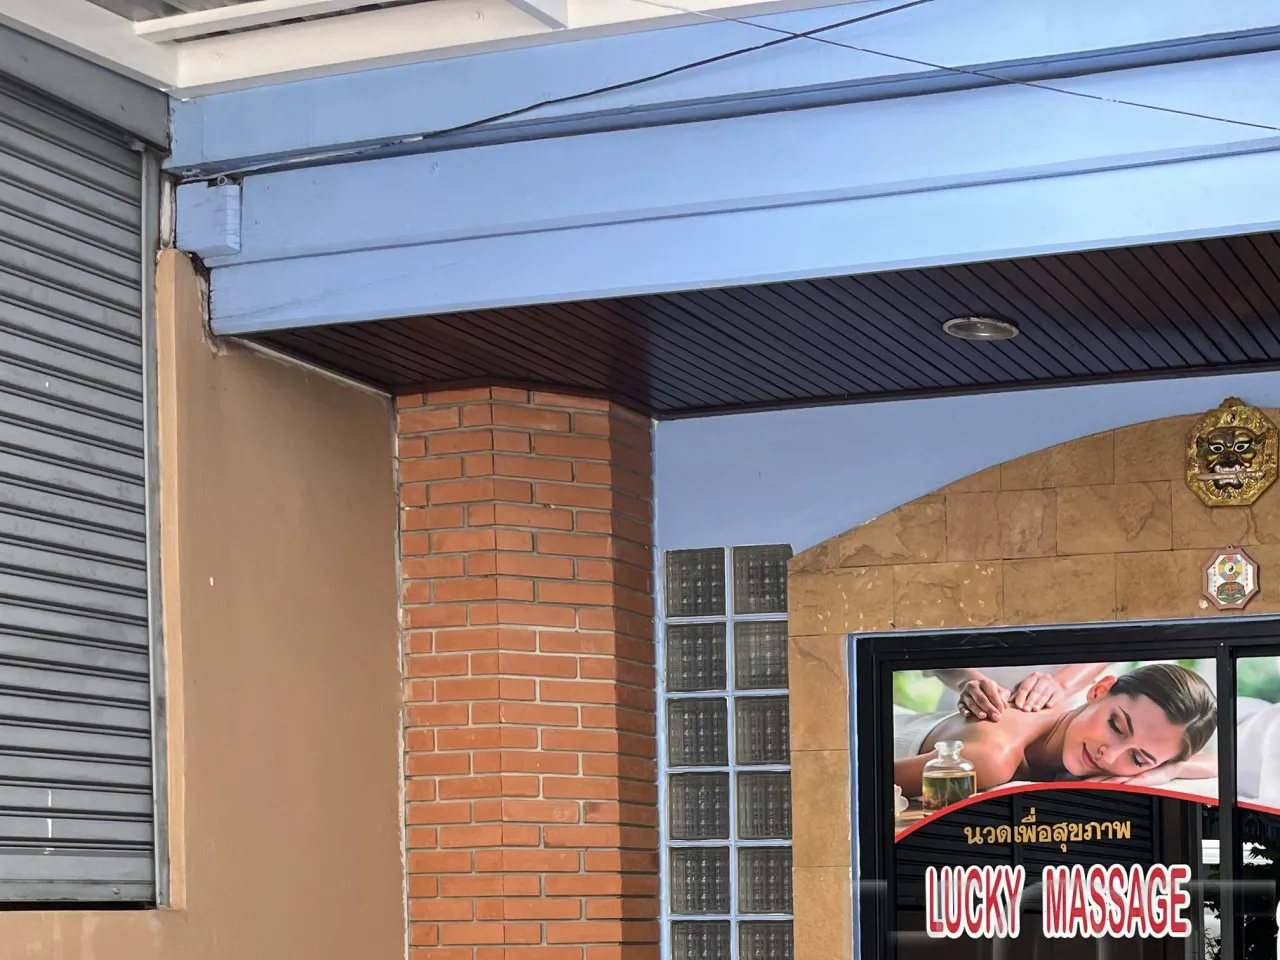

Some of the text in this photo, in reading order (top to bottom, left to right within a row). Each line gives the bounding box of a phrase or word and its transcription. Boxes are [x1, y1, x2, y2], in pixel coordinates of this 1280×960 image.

[963, 807, 1131, 853] นวดเพื่อสุขภาพ
[925, 863, 1191, 939] LUCKY MASSAGE
